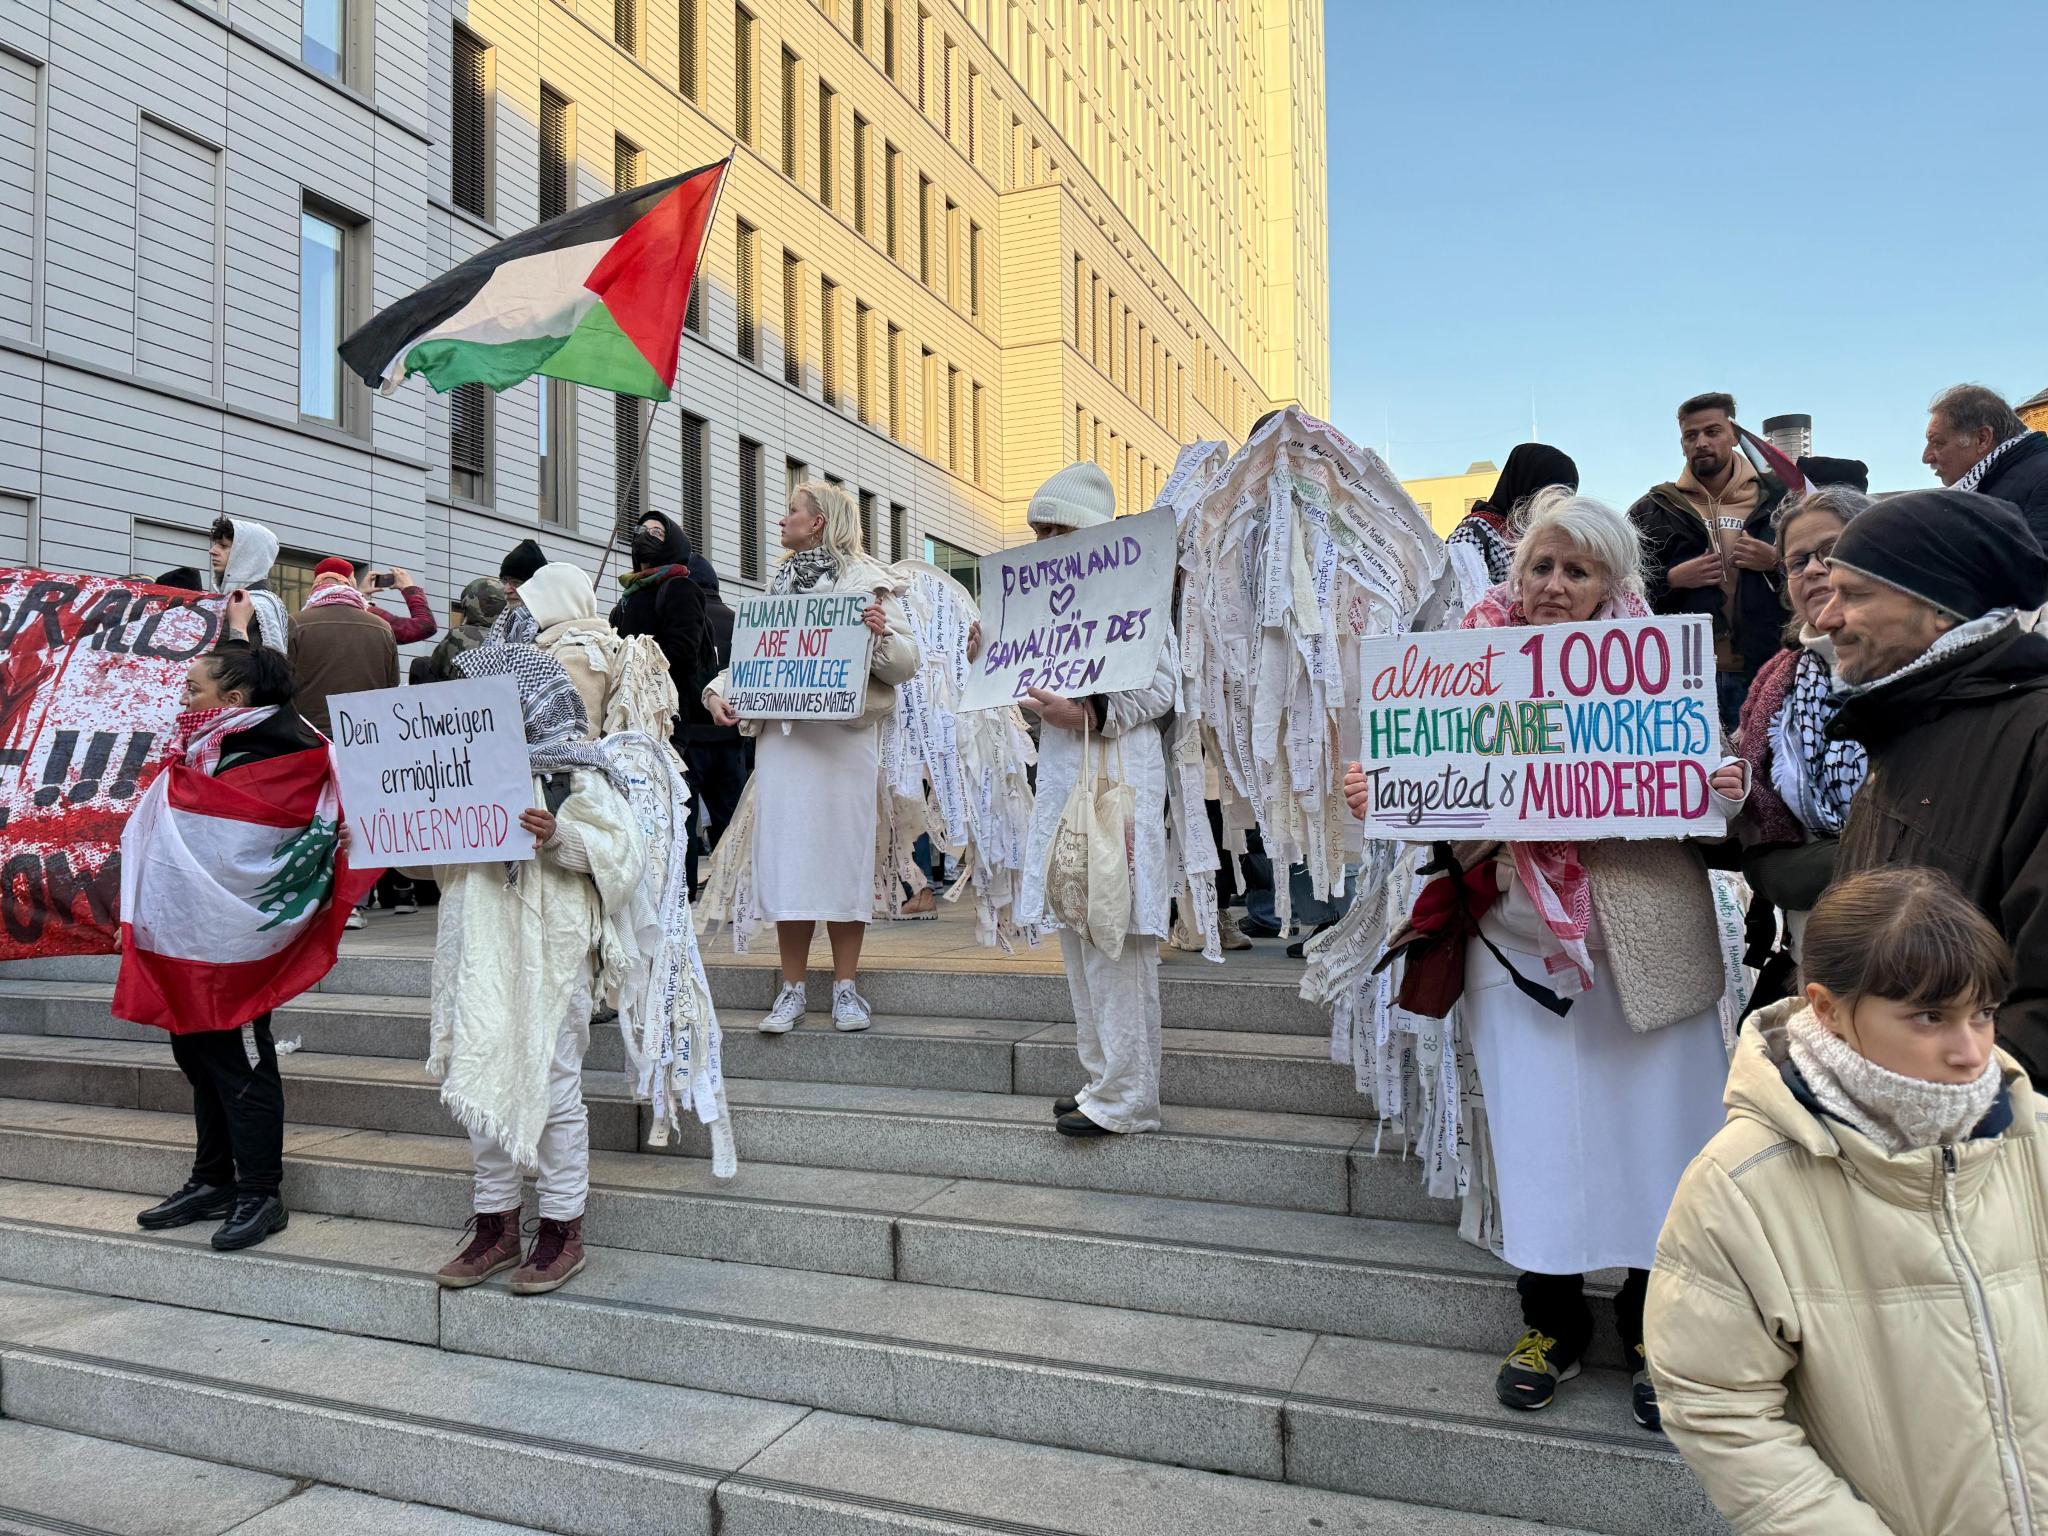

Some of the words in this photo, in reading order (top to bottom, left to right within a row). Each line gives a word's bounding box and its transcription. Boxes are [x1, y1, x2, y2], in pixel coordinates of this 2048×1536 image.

[1002, 536, 1141, 597] DEUTSCHLAND
[737, 600, 799, 628] HUMAN
[805, 597, 866, 626] RIGHTS
[754, 629, 789, 657] ARE
[797, 628, 832, 657] NOT
[985, 609, 1098, 676] BANALITÄT
[1106, 608, 1151, 644] DES
[1372, 644, 1505, 700] almost
[1519, 627, 1671, 698] 1.000
[1682, 623, 1702, 690] !!
[732, 660, 773, 688] WHITE
[775, 659, 851, 688] PRIVILEGE
[1012, 655, 1106, 698] BÖSEN
[340, 711, 379, 747] Dein
[393, 702, 494, 743] Schweigen
[1370, 701, 1563, 759] HEALTHCARE
[1565, 696, 1710, 754] WORKERS
[382, 746, 473, 802] ermöglicht
[1365, 762, 1494, 825] Targeted
[1519, 760, 1708, 820] MURDERED
[360, 804, 508, 854] VÖLKERMORD
[1423, 1034, 1437, 1052] 38
